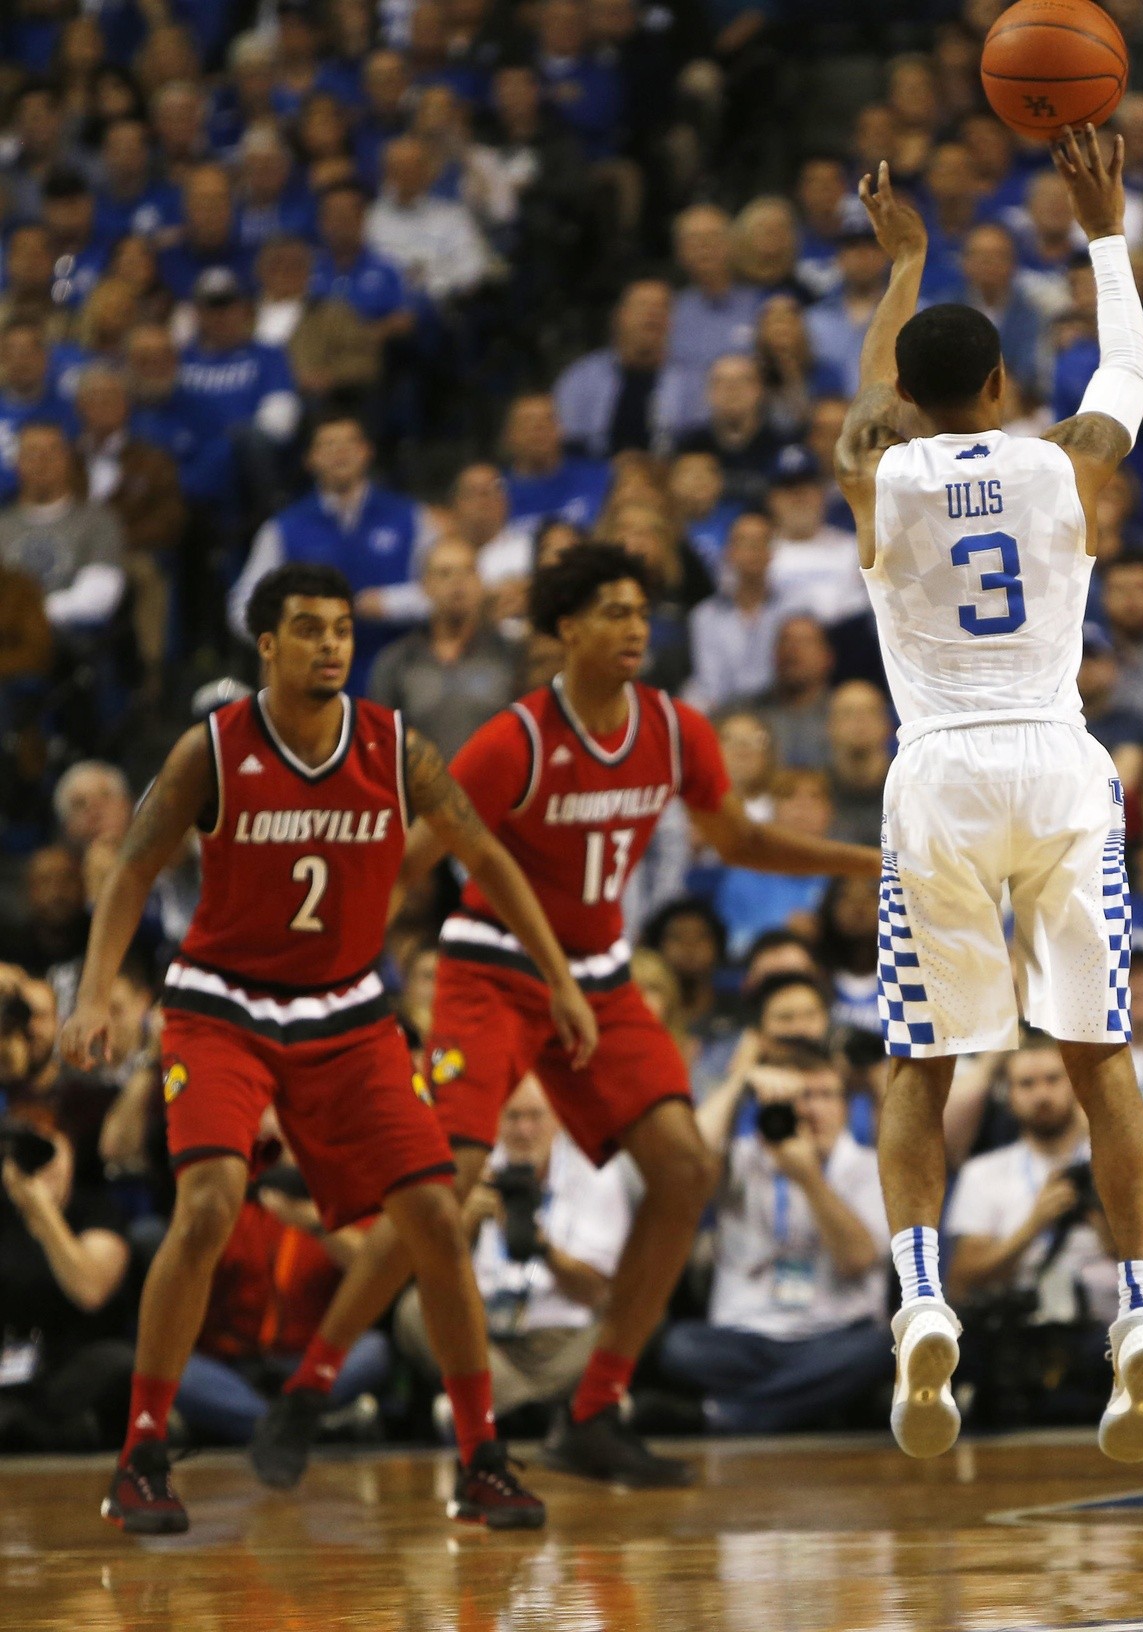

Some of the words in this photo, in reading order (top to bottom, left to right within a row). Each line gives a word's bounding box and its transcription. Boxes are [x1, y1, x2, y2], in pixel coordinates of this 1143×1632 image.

[945, 479, 1004, 519] ULIS
[950, 531, 1027, 636] 3
[233, 808, 393, 844] LOUISVILLE
[289, 854, 328, 932] 2
[582, 828, 636, 906] 13
